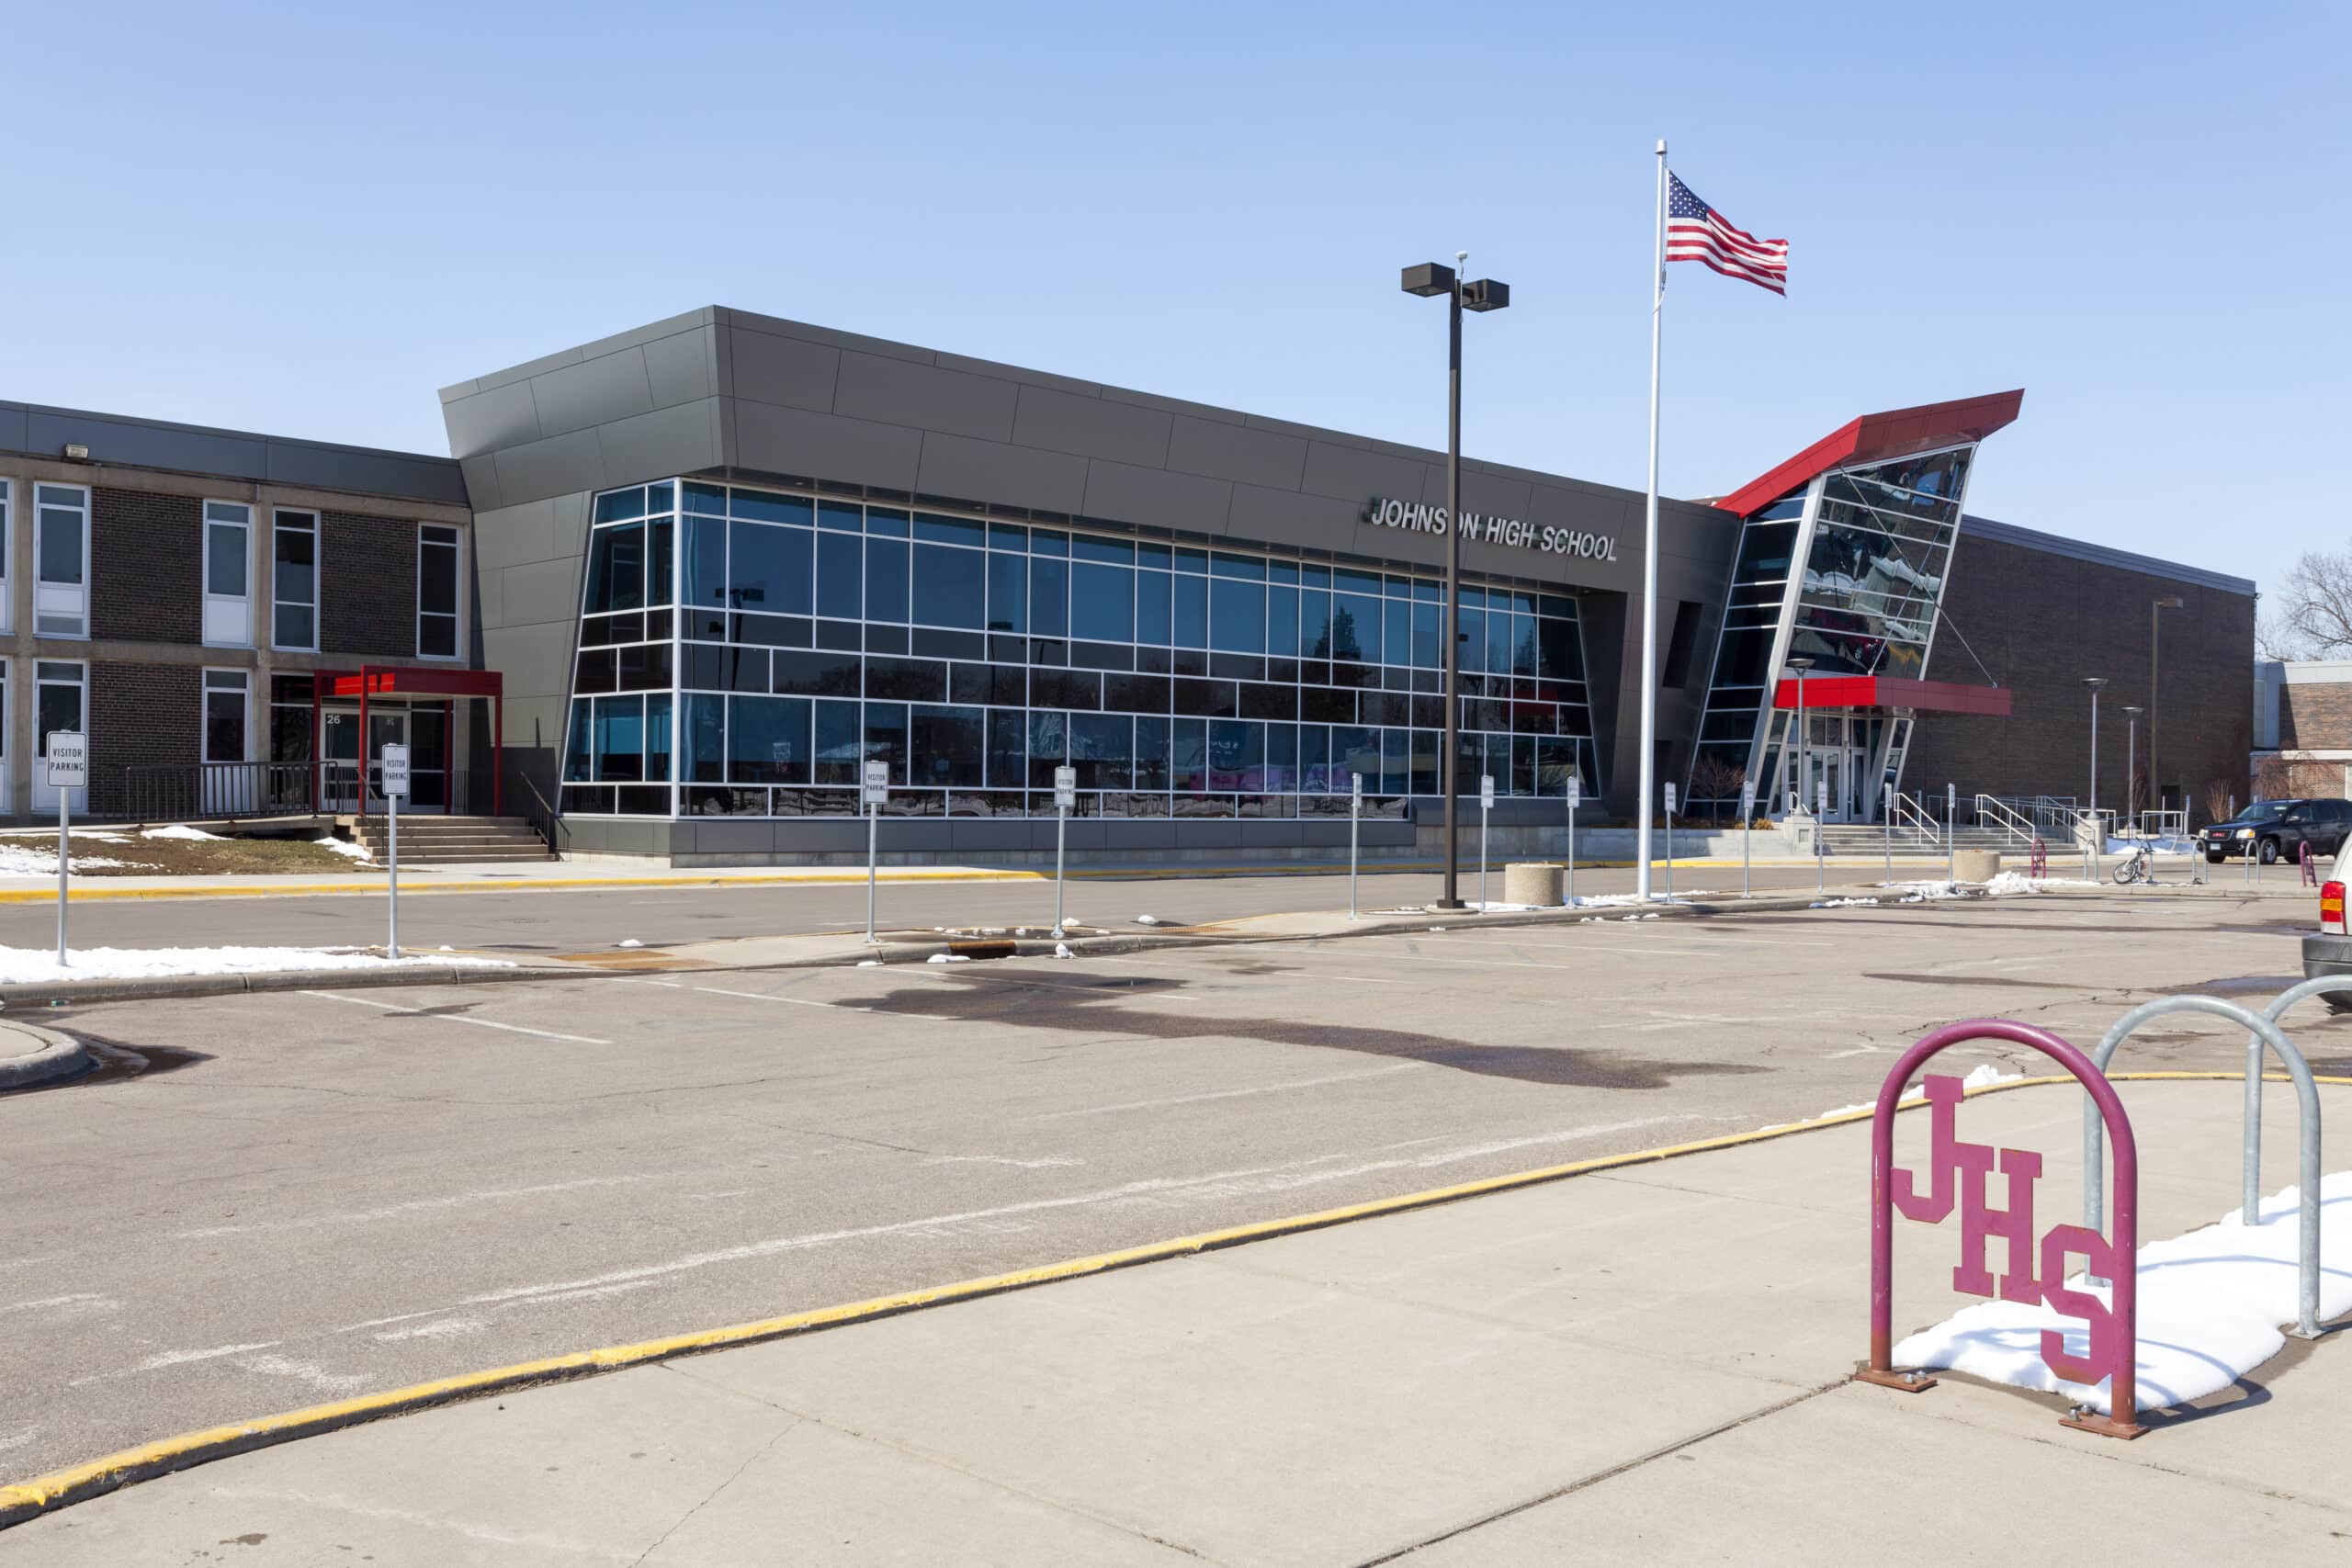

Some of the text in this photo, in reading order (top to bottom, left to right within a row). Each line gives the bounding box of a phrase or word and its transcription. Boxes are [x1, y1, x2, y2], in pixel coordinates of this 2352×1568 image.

[1372, 498, 1618, 562] JOHNSN HIGH SCHOOL
[326, 715, 341, 725] 26
[52, 748, 83, 758] VISITOR
[50, 761, 84, 773] PARKING
[386, 759, 406, 768] VISITOR
[385, 772, 407, 780] PARKING
[1890, 1074, 2114, 1385] JHS
